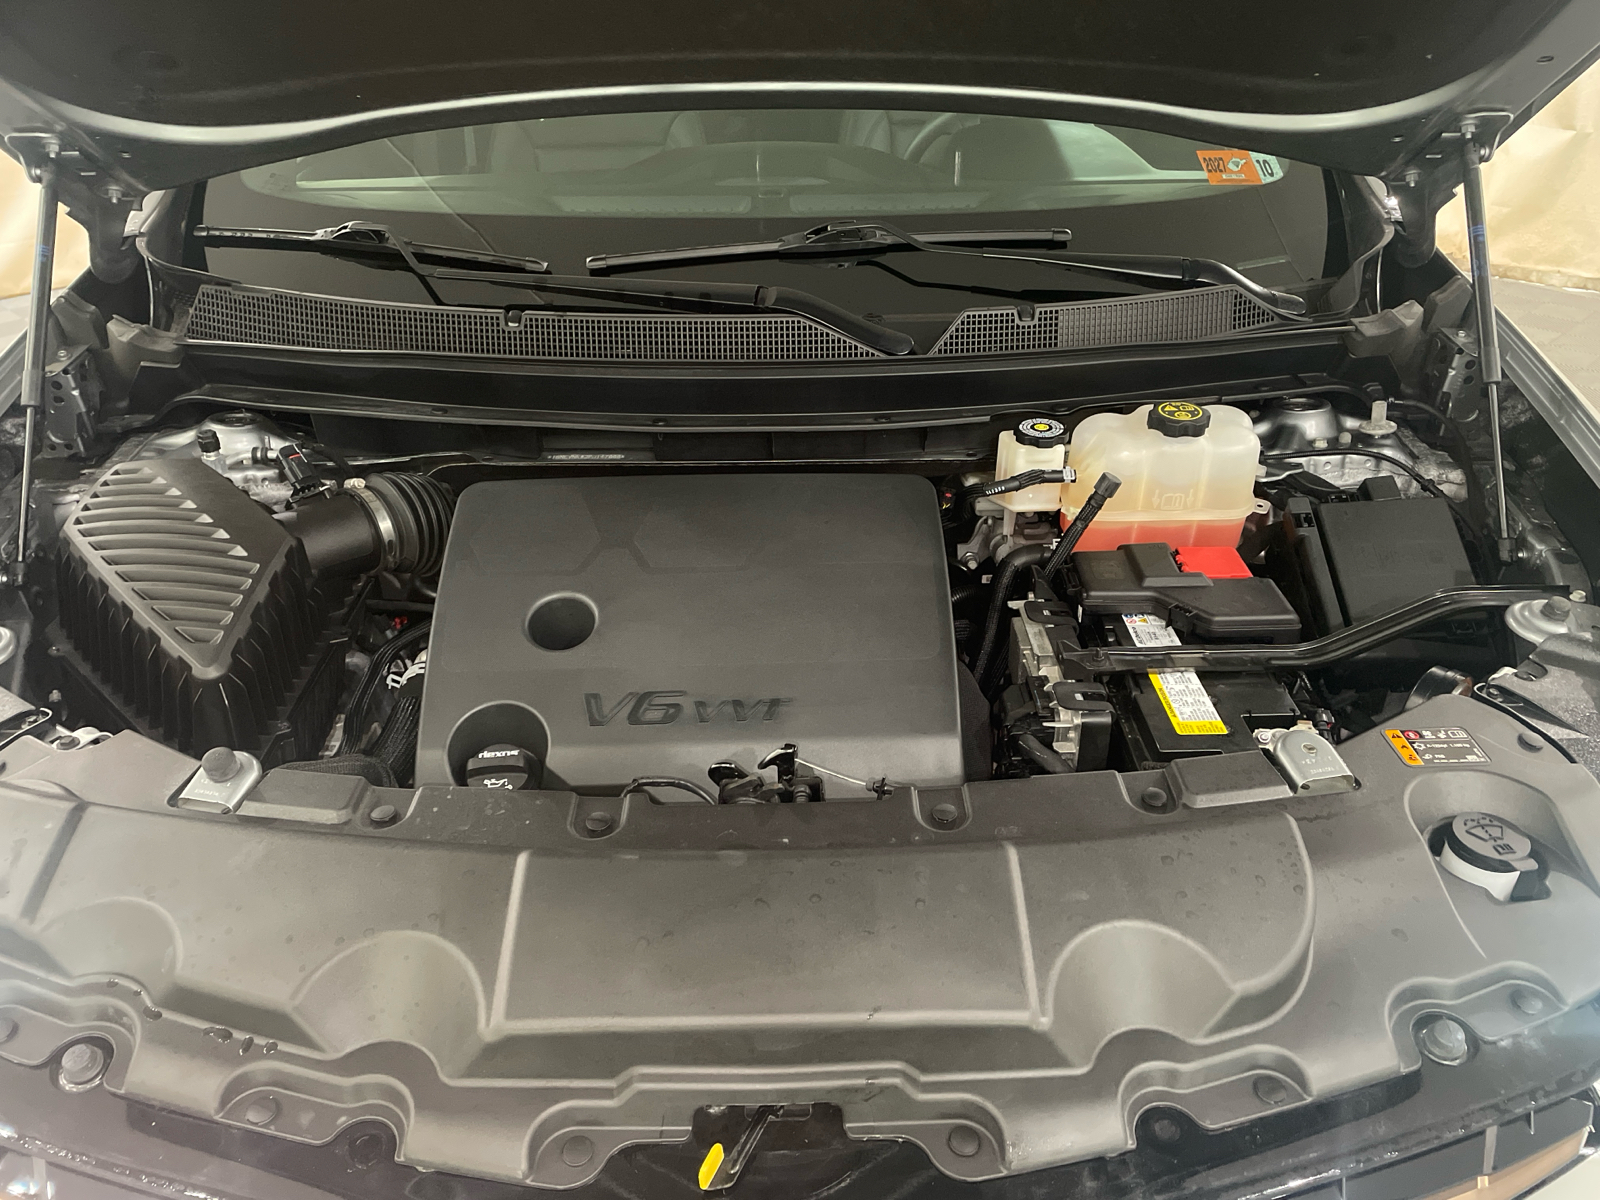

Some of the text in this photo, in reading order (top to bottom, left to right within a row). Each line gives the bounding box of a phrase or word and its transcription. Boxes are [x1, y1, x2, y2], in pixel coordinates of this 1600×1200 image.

[1202, 156, 1227, 173] 2027
[1255, 159, 1275, 178] 10
[584, 690, 793, 726] V6 VVT
